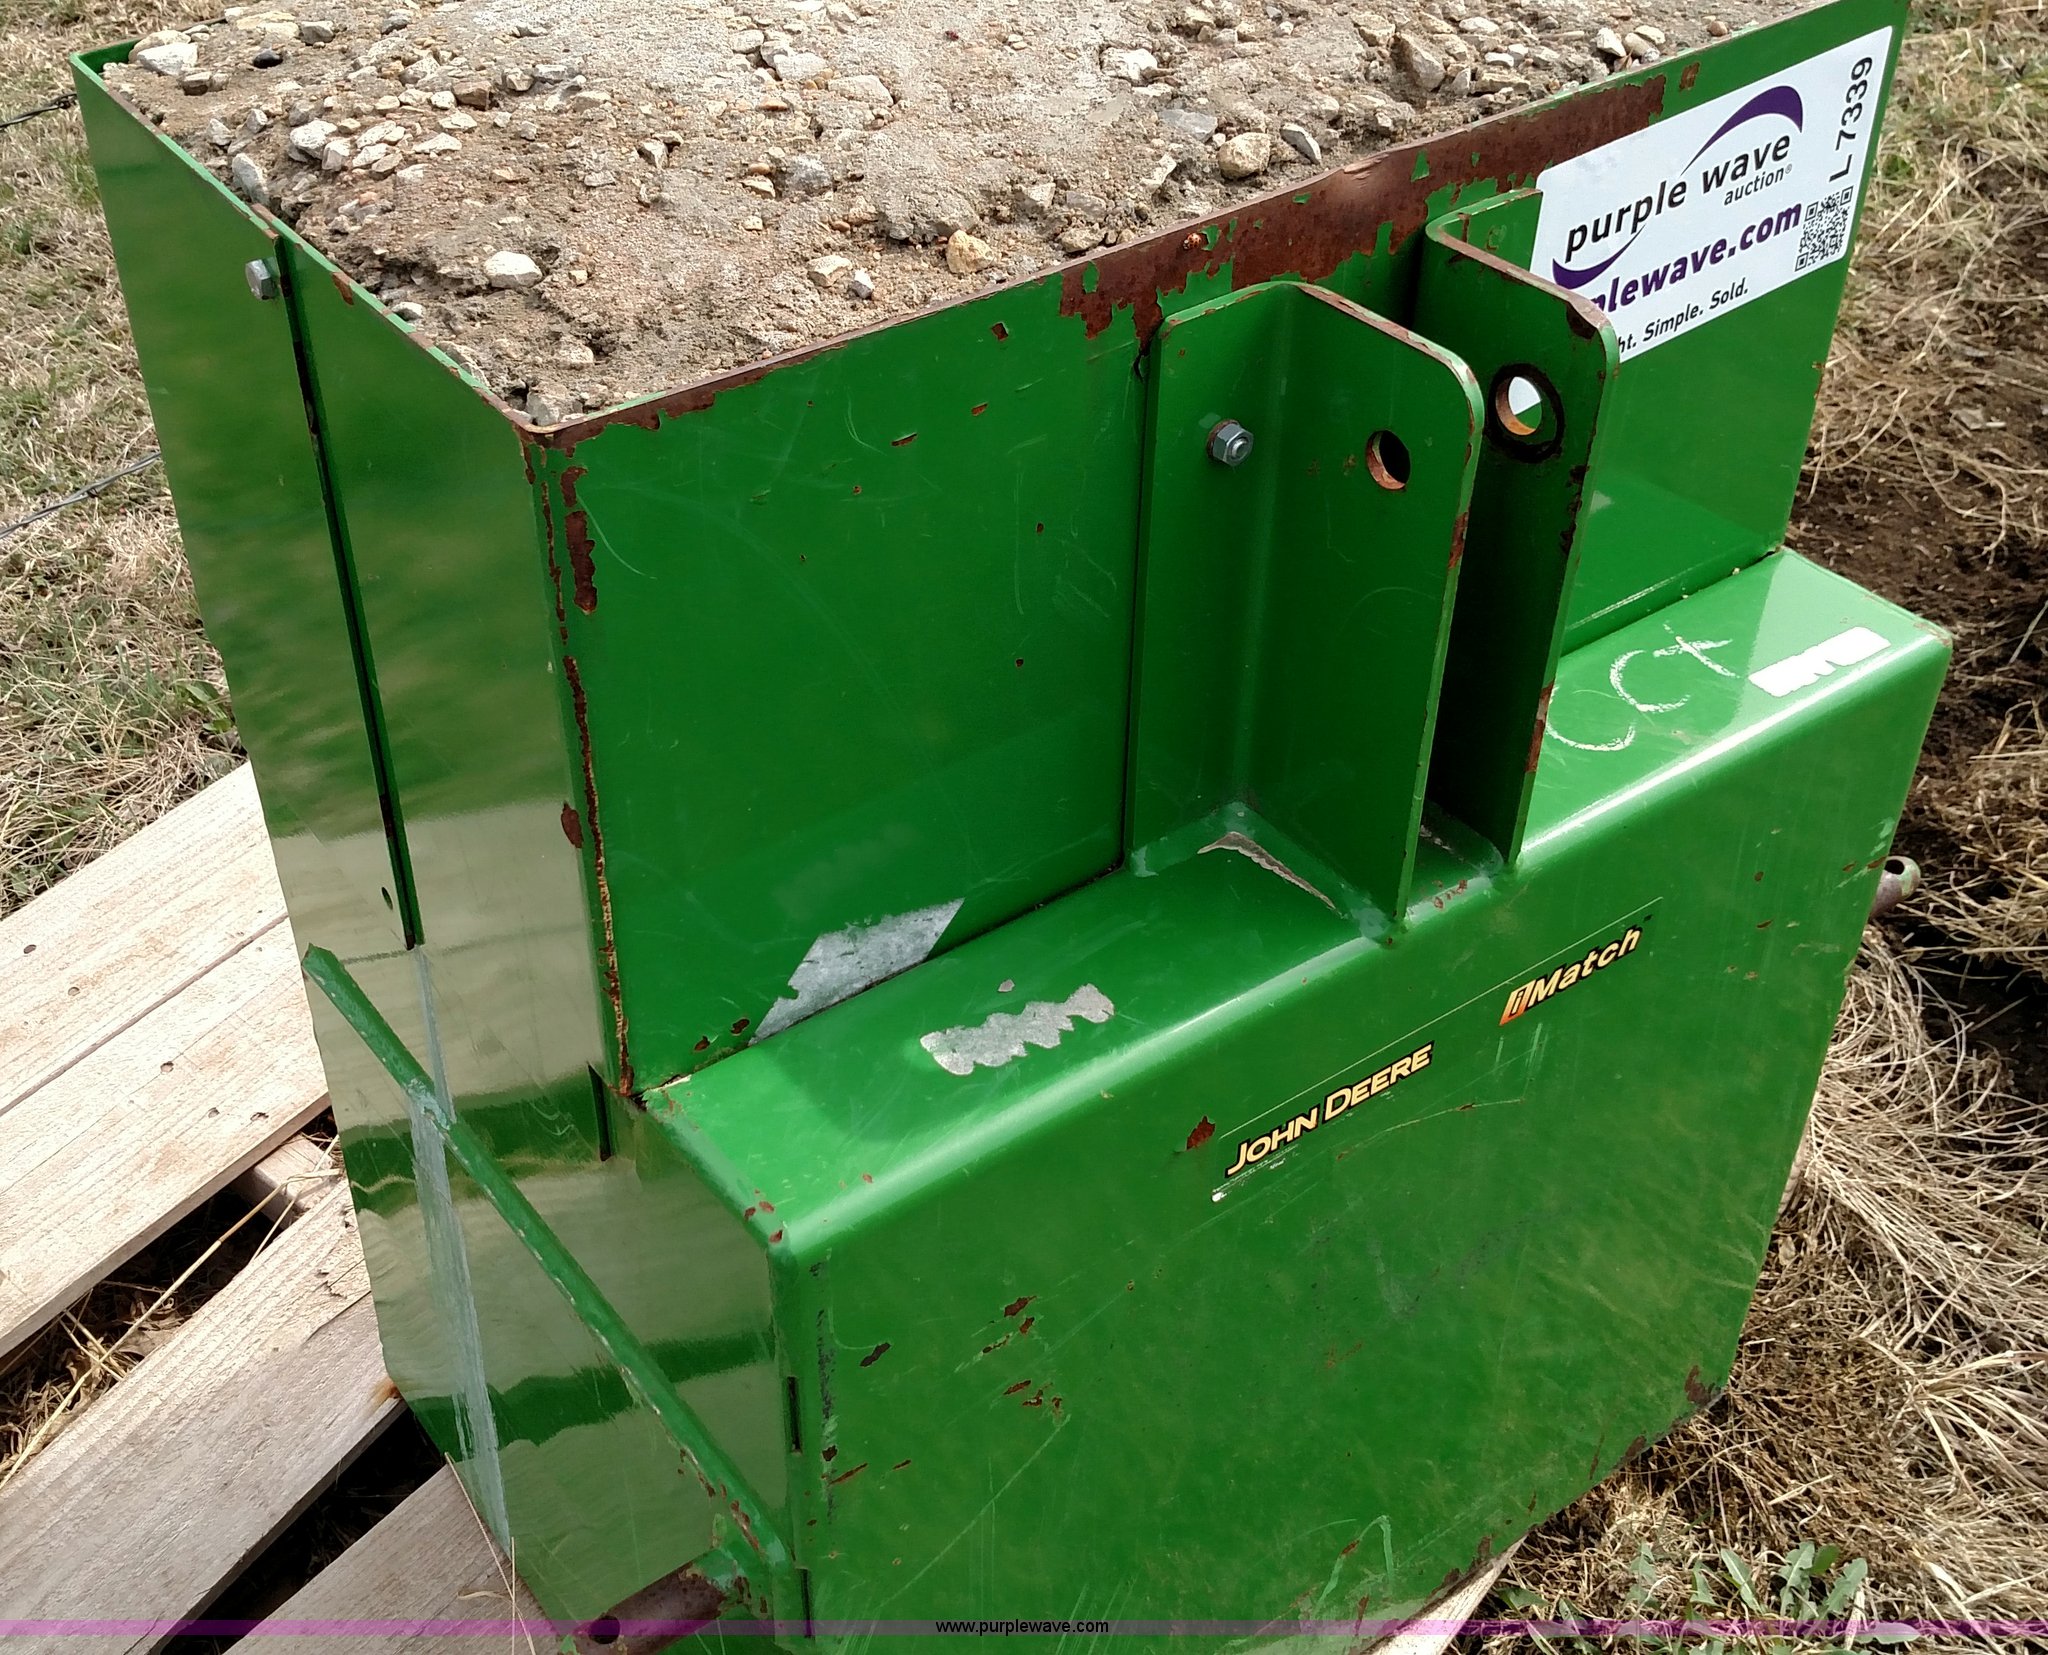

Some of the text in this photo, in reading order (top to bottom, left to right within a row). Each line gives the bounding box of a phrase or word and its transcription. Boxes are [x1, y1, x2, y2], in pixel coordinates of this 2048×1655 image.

[1828, 56, 1874, 183] L 7339
[1564, 134, 1790, 264] purple wave
[1643, 303, 1703, 342] Simple.
[1709, 277, 1749, 309] Sold.
[1224, 1041, 1435, 1178] JOHN DEERE
